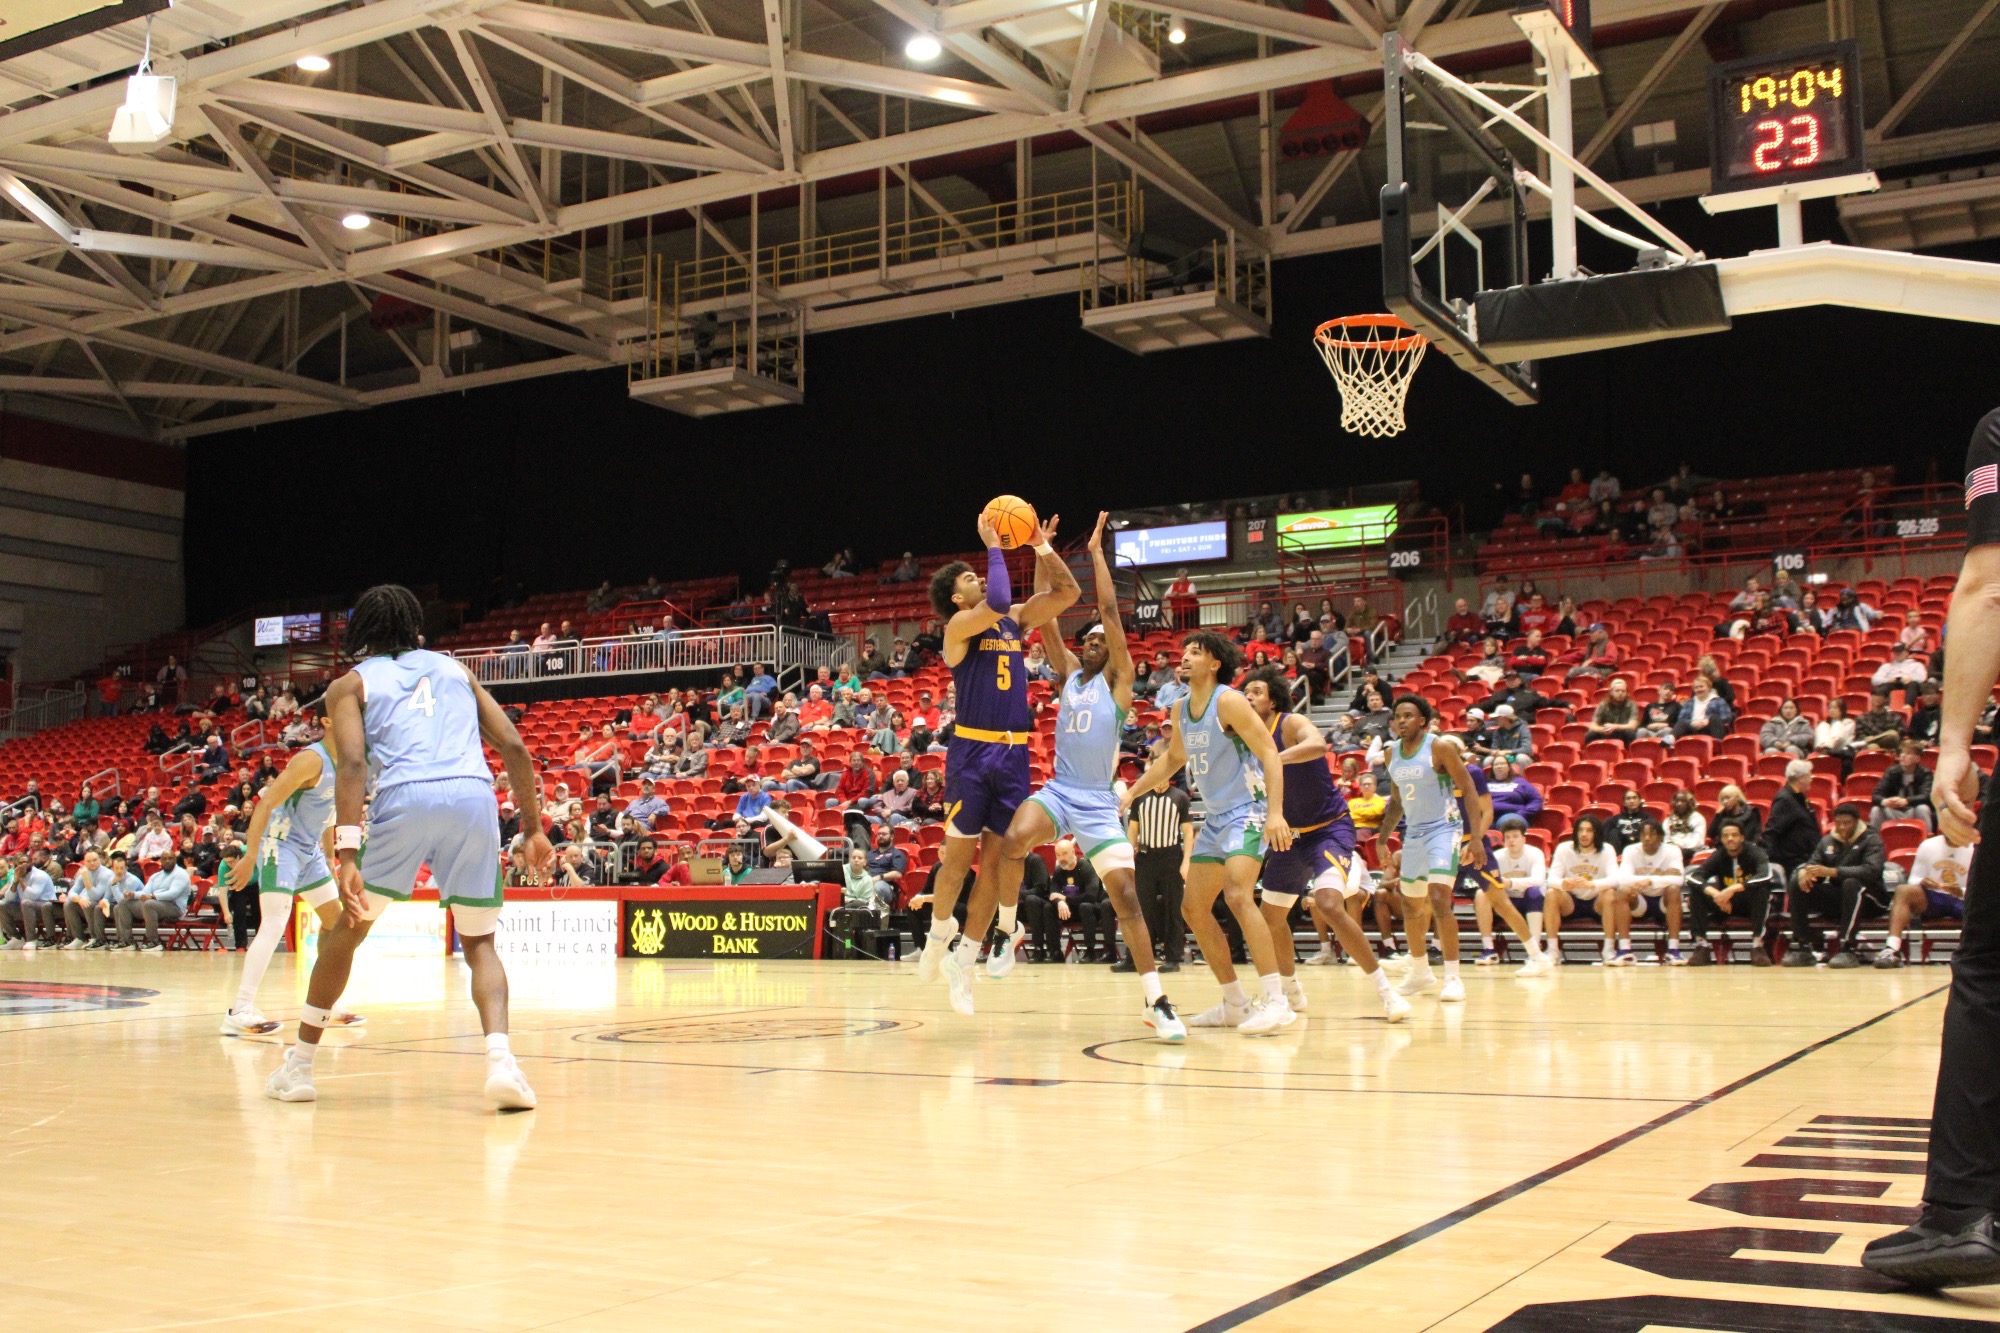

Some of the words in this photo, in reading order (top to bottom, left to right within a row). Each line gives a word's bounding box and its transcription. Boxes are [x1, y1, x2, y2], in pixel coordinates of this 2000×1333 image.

[1741, 67, 1842, 113] 19:04
[1755, 115, 1819, 171] 23
[1248, 520, 1266, 531] 207
[1150, 536, 1198, 547] FURNITURE
[1200, 533, 1227, 542] FINDS
[1390, 551, 1420, 567] 206
[1774, 555, 1804, 570] 106
[1136, 604, 1159, 619] 107
[546, 657, 563, 670] 108
[996, 655, 1012, 691] 5
[243, 677, 256, 688] 109
[407, 676, 437, 717] 4
[1065, 709, 1093, 733] 10
[1189, 752, 1209, 776] 15
[1394, 765, 1424, 781] SEMO
[1405, 783, 1417, 801] 2
[722, 912, 737, 931] &
